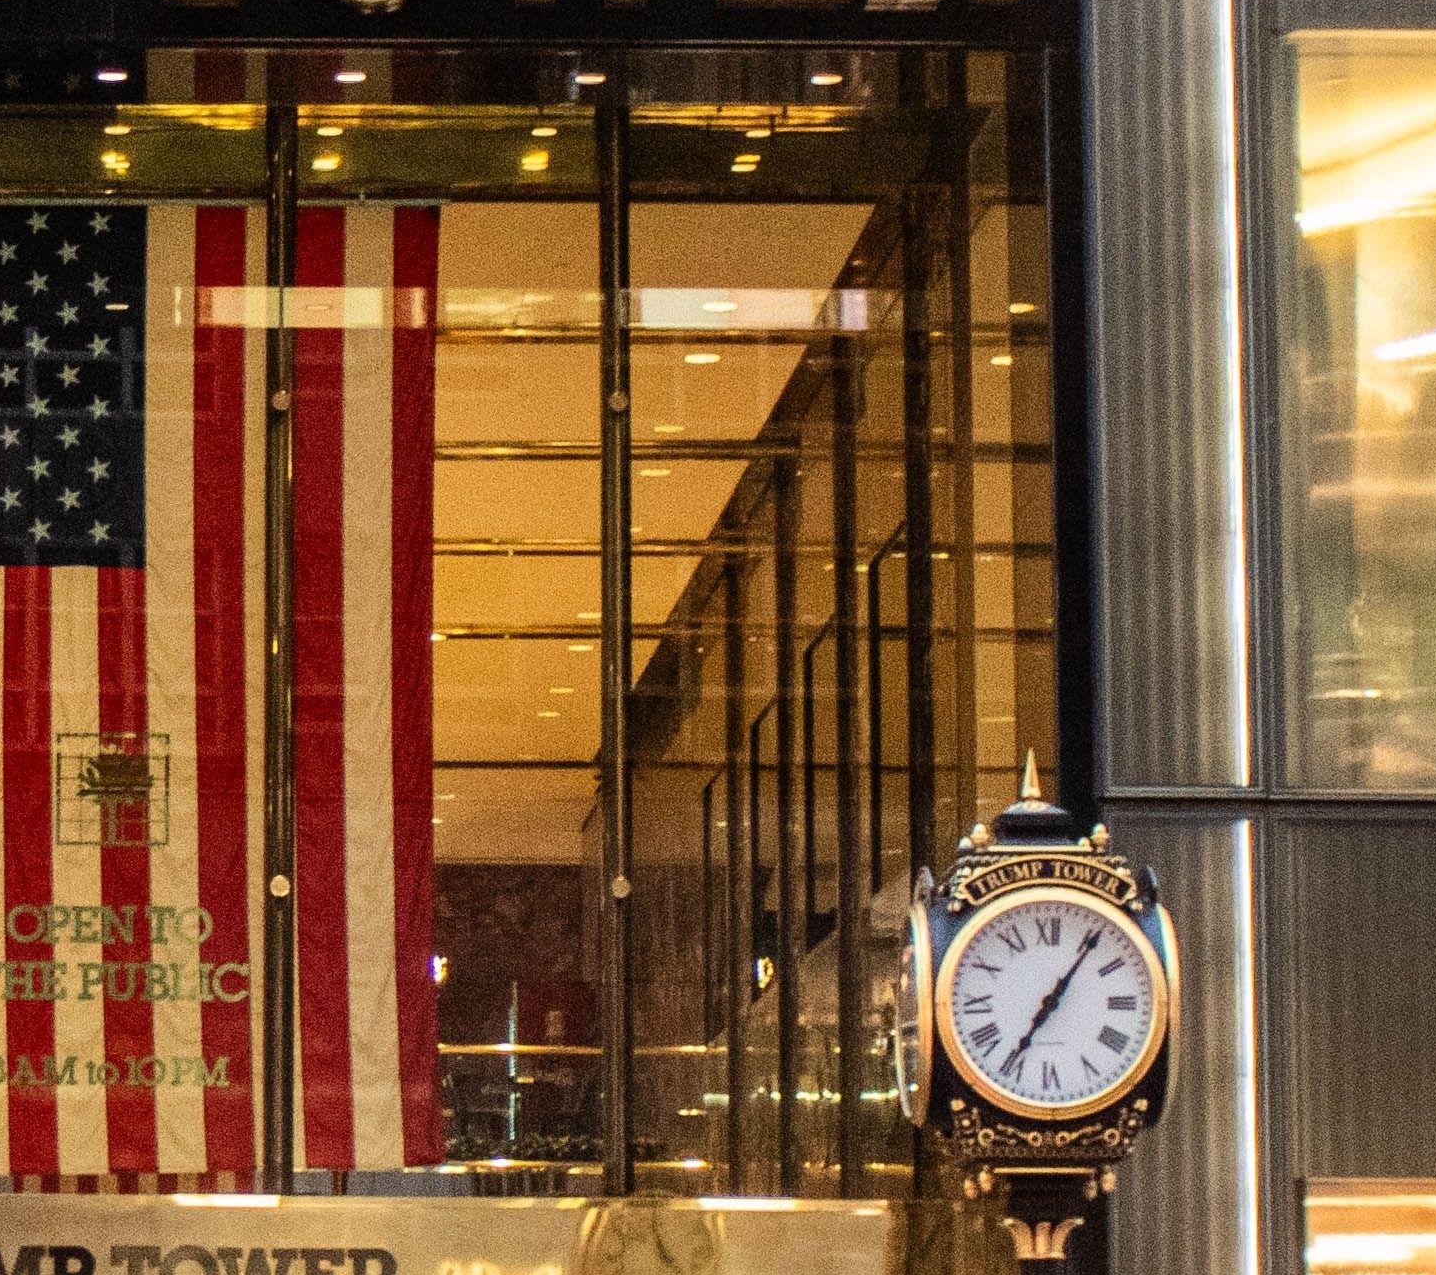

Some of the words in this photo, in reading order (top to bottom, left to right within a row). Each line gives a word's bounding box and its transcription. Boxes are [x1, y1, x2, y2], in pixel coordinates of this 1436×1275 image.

[974, 862, 1043, 895] TRUMP
[1054, 861, 1121, 892] TOWER
[7, 904, 136, 944] OPEN
[147, 906, 213, 945] TO
[78, 963, 250, 1003] PUBLIC
[86, 1058, 121, 1086] to
